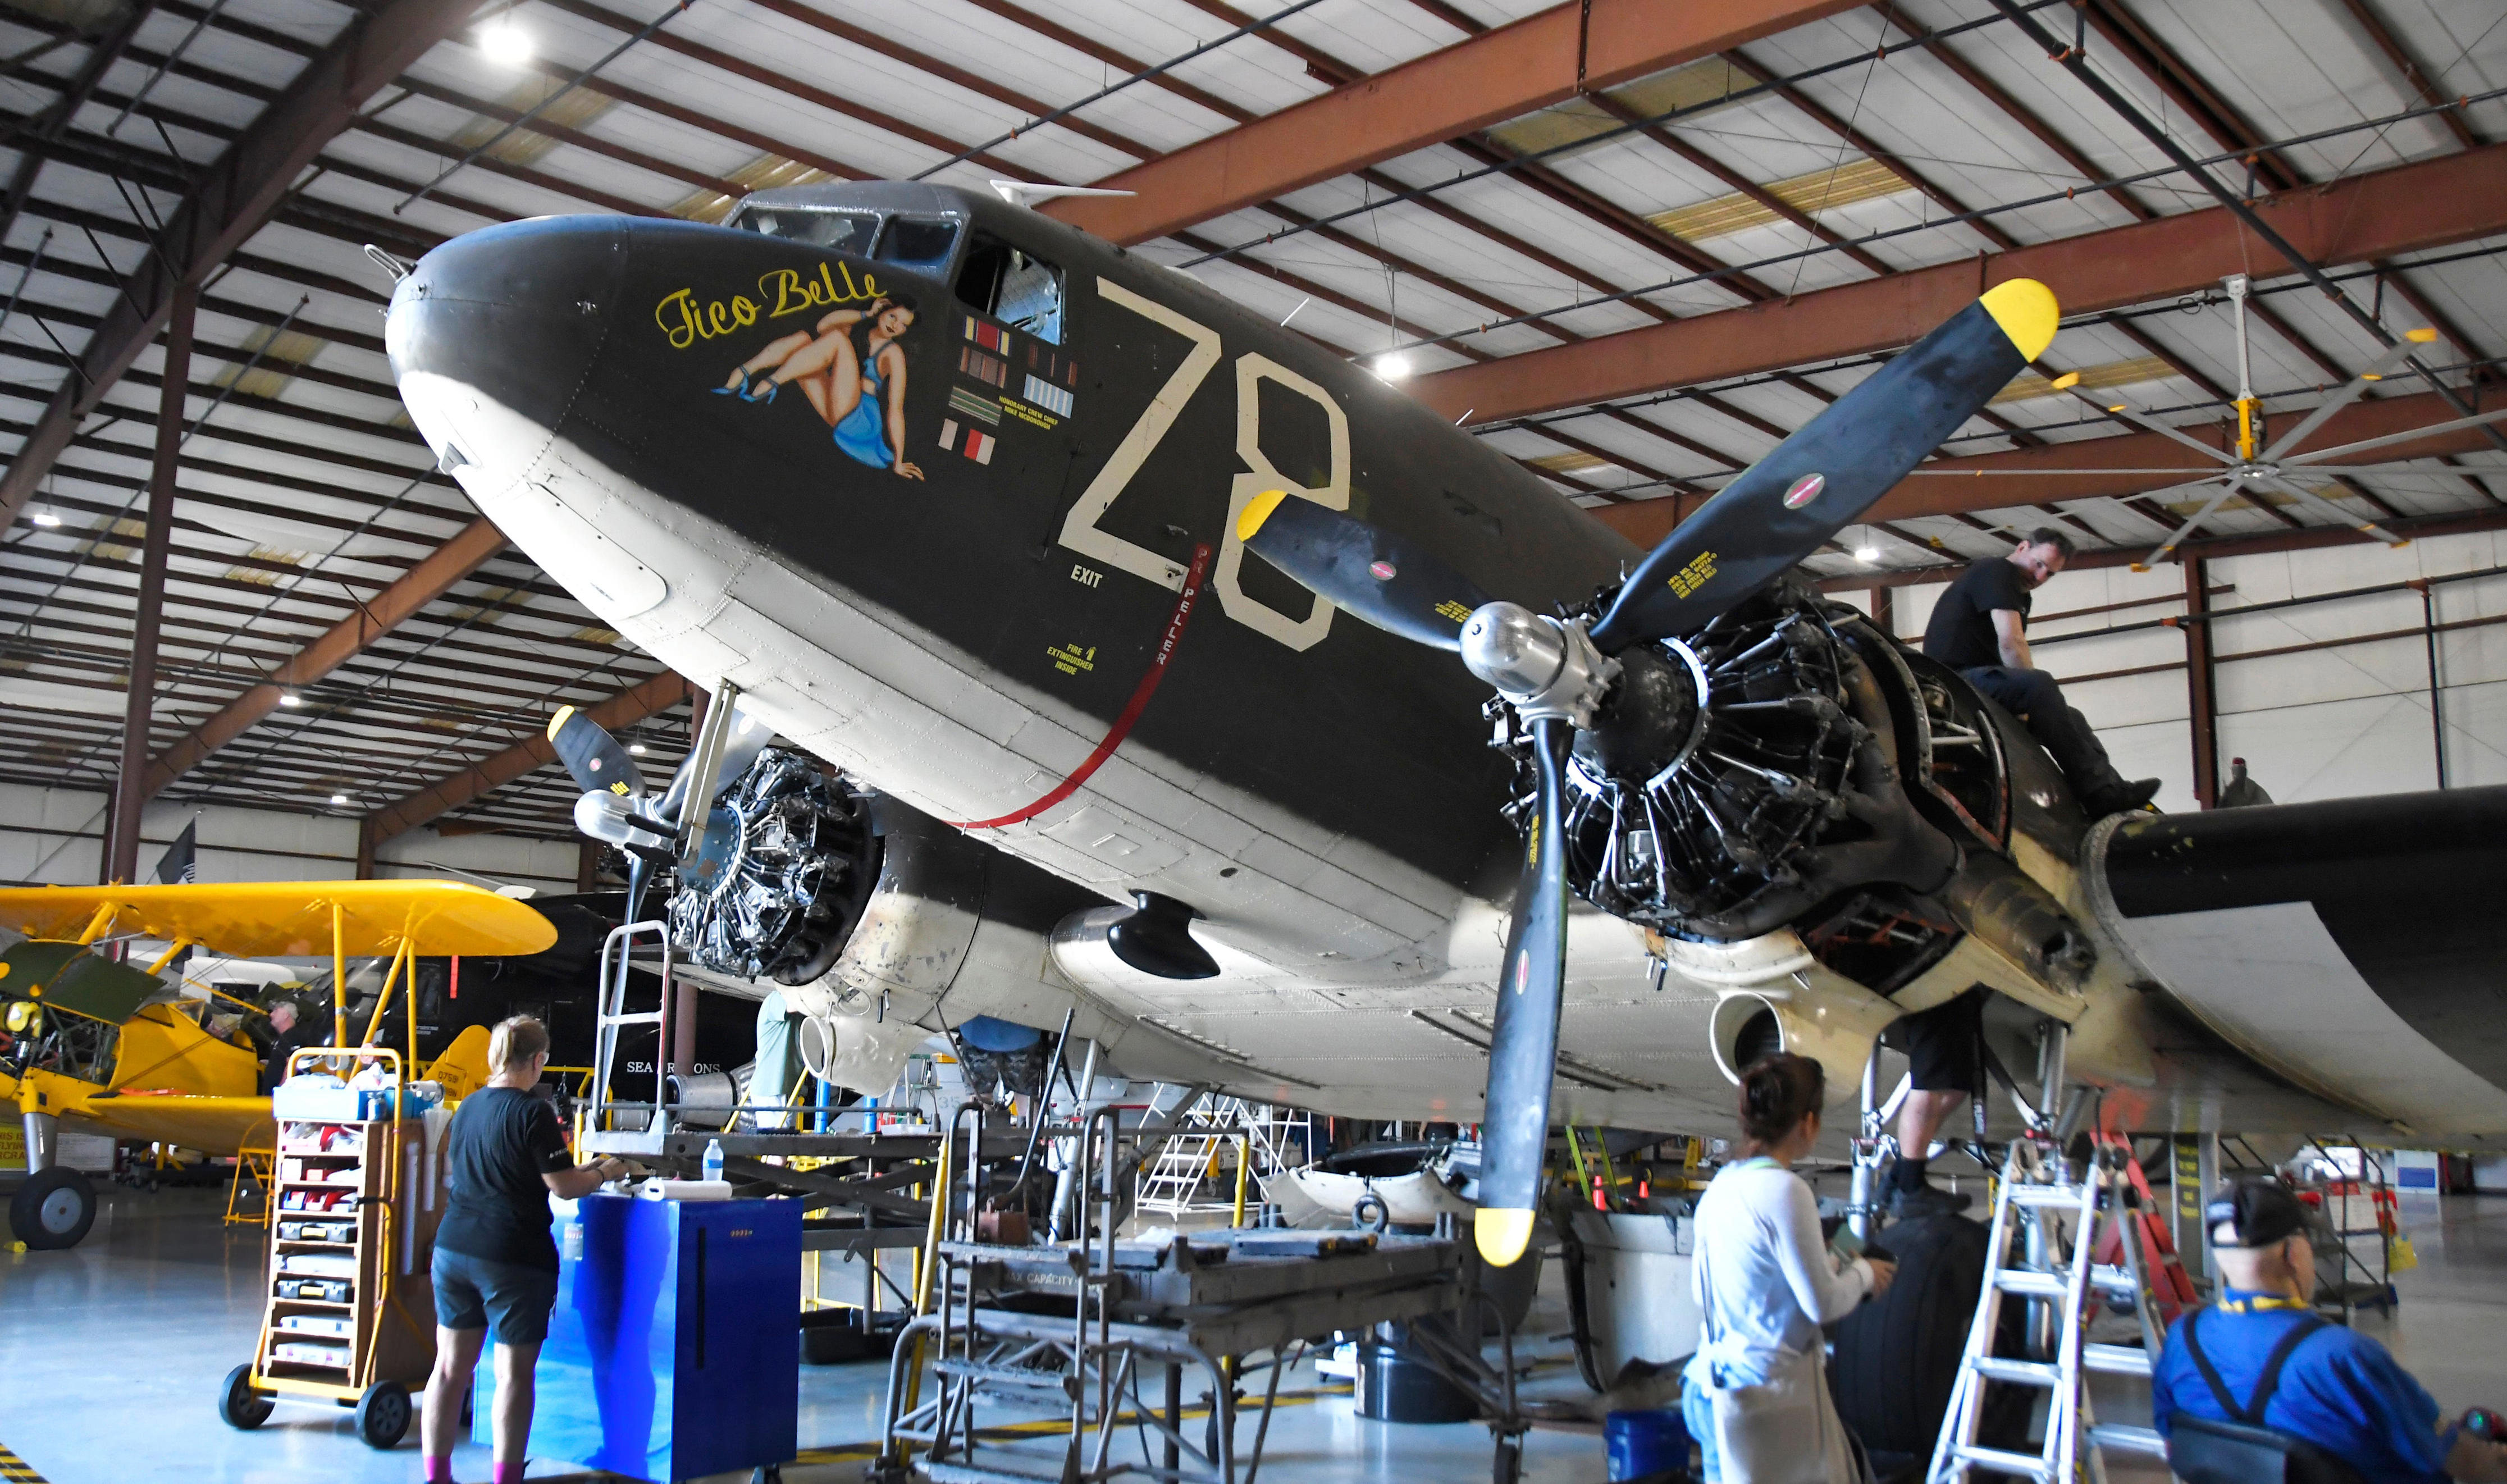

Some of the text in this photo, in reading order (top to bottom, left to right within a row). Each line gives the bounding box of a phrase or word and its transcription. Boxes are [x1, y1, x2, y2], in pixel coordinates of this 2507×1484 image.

[655, 260, 887, 348] Tico Belle
[999, 395, 1058, 426] HONORARY CREW CHIEF
[1070, 564, 1103, 588] EXIT
[1047, 646, 1094, 672] EXTINGUISHER
[1067, 643, 1083, 656] FIRE
[1055, 660, 1077, 675] INSIDE
[627, 1061, 653, 1073] SEA
[1026, 1272, 1074, 1286] CAPACITY
